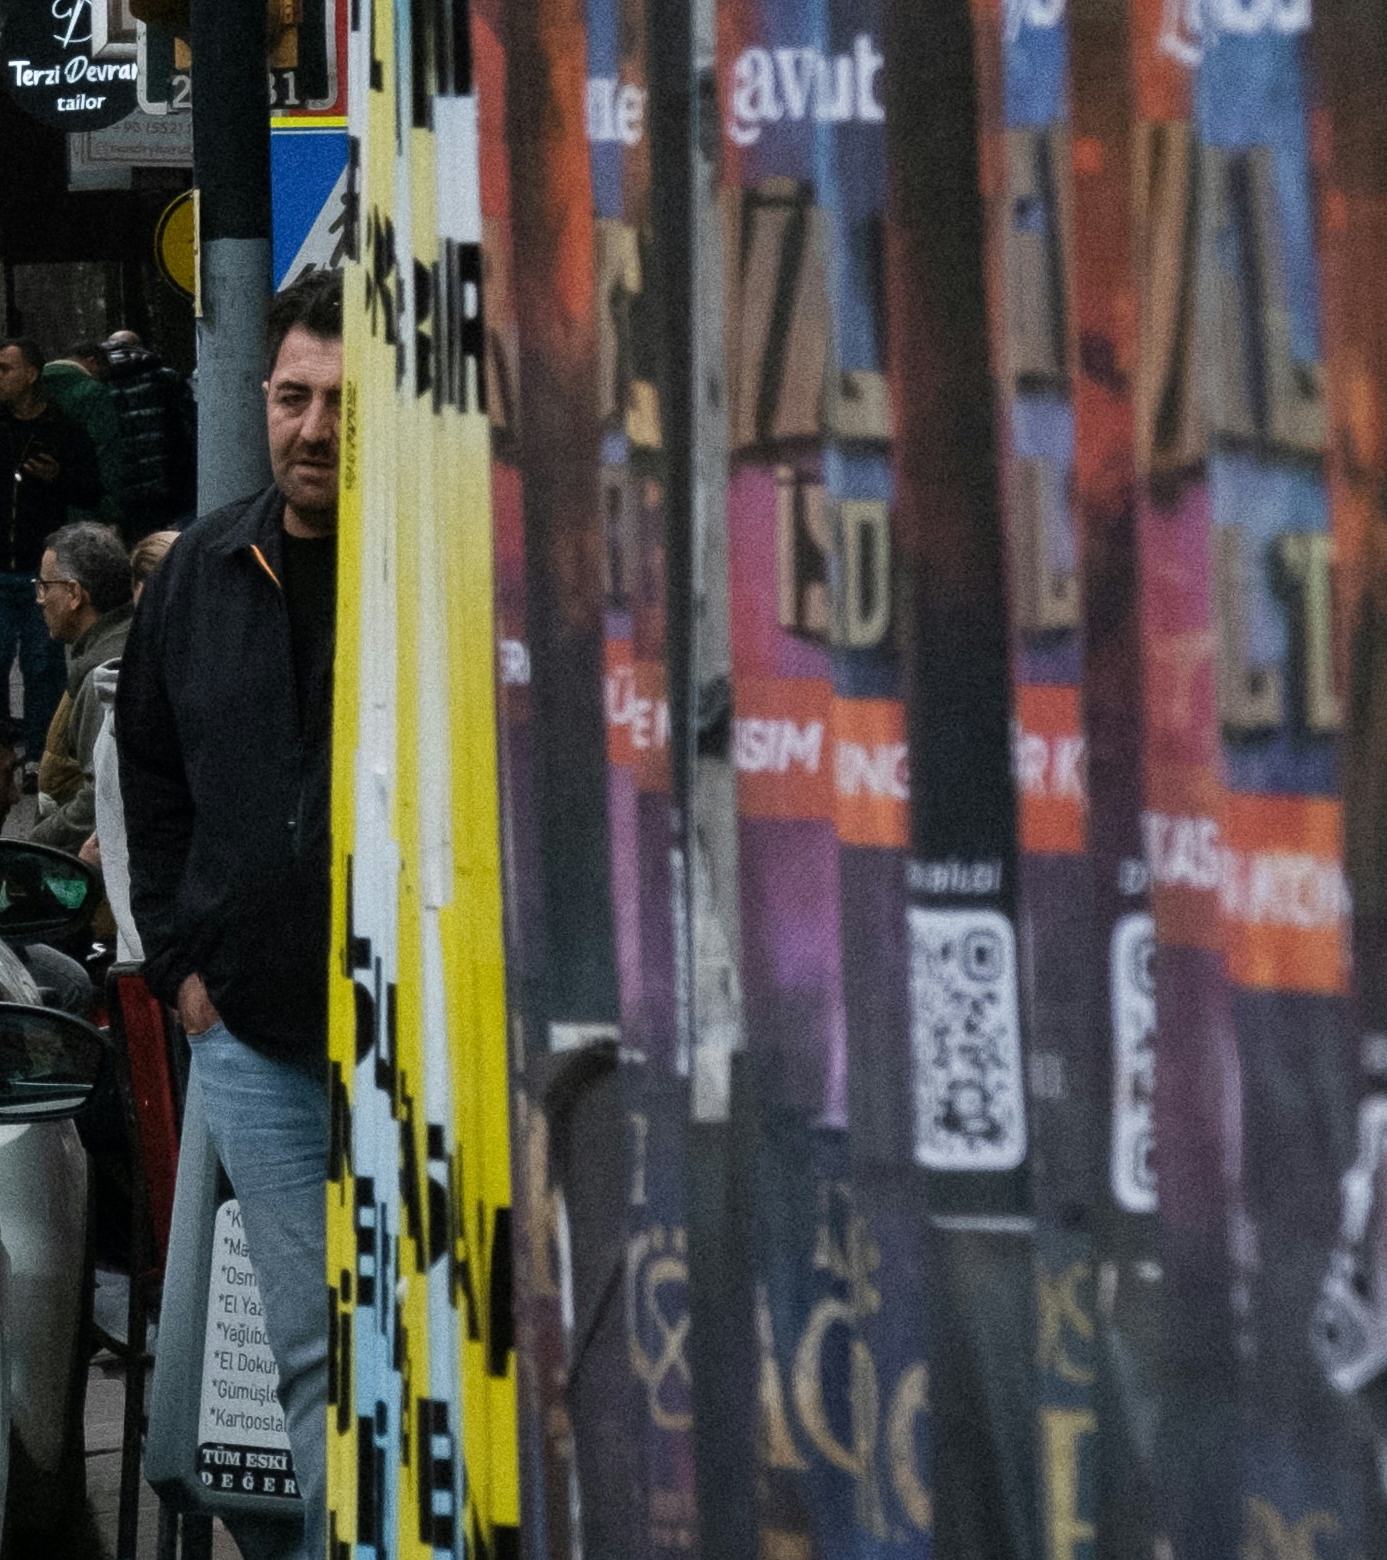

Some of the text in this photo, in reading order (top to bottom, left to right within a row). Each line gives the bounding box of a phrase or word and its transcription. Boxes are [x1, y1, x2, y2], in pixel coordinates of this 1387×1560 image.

[8, 59, 60, 87] Terzi
[57, 94, 107, 112] tailor
[202, 1446, 288, 1471] TÜM ESKİ
